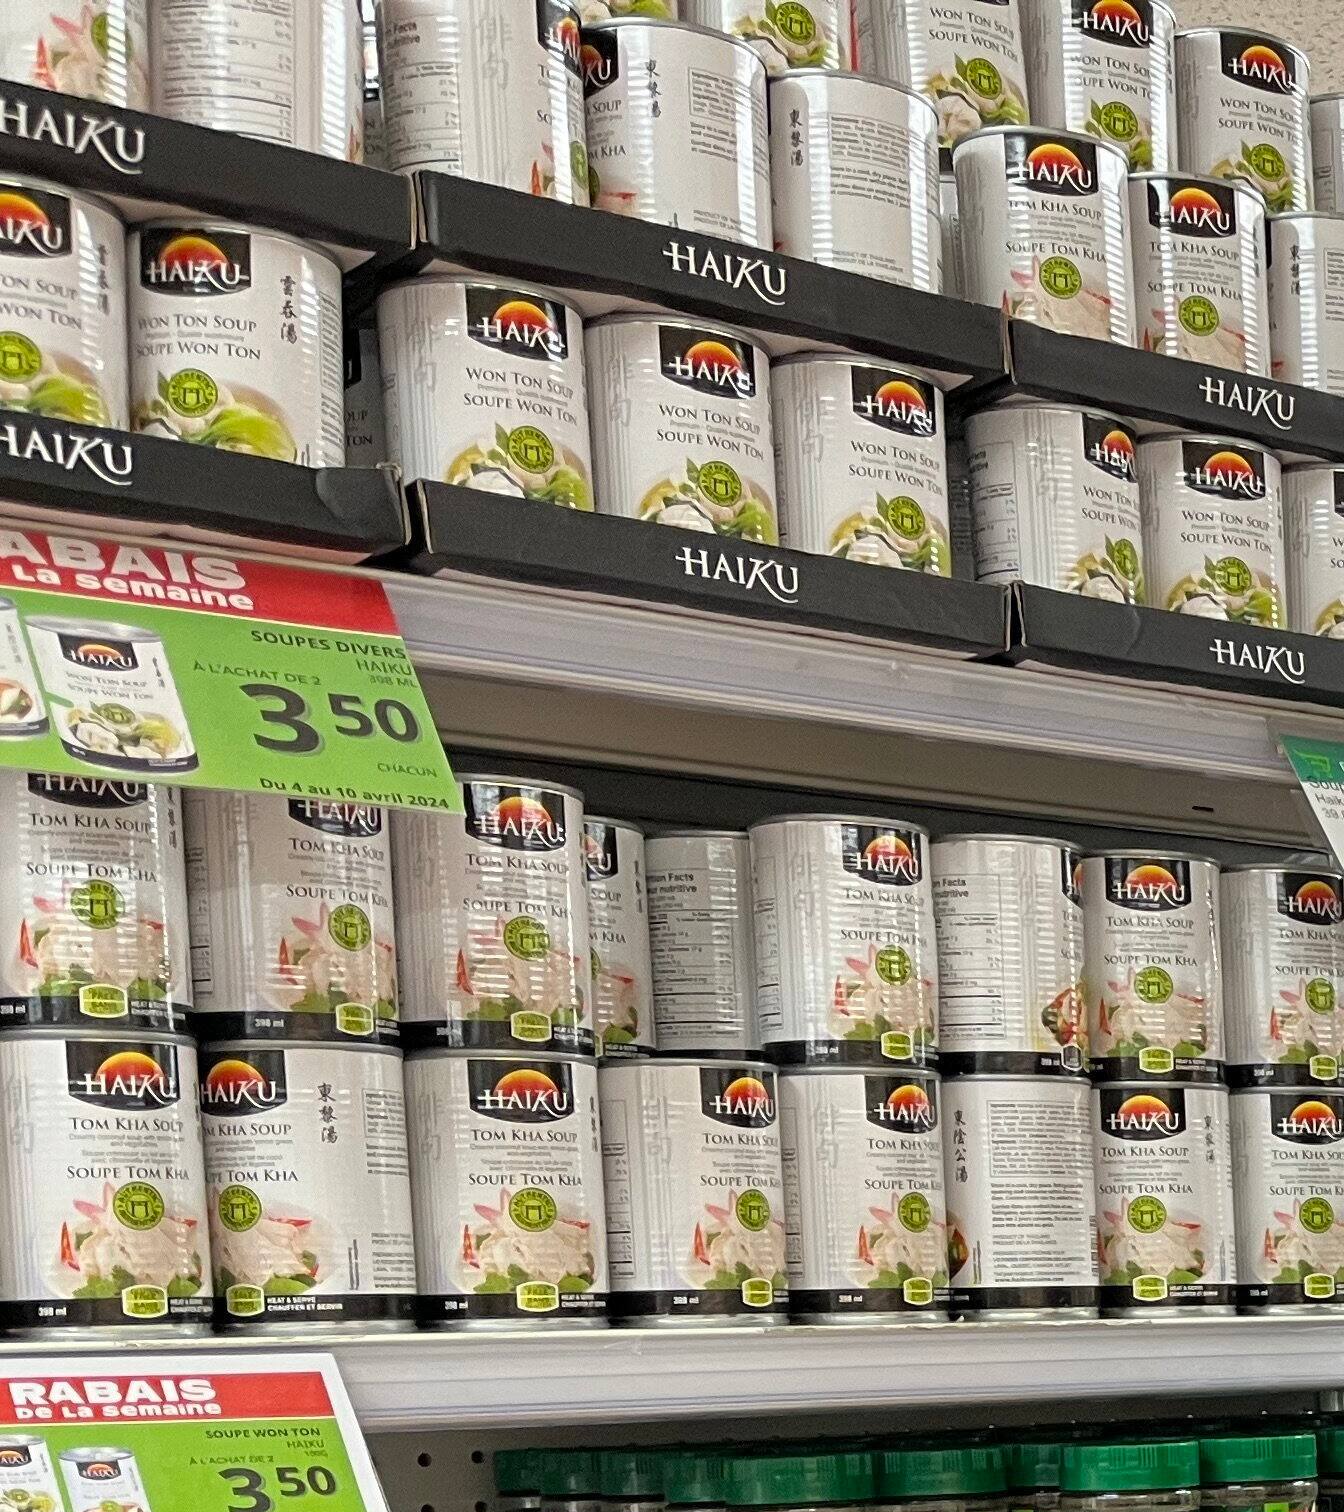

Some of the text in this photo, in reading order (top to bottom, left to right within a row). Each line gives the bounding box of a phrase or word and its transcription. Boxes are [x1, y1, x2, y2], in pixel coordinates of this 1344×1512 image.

[1081, 8, 1152, 46] HAIKU
[0, 100, 145, 175] HAIKU
[1016, 158, 1093, 198] HAIKU
[146, 258, 250, 287] HAIKU
[662, 241, 787, 306] HAIKU
[465, 365, 508, 384] WON
[512, 372, 545, 390] TON
[463, 391, 513, 411] SOUPE
[516, 398, 553, 417] WON
[1199, 376, 1296, 431] HAIKU
[12, 563, 254, 611] La semaine
[675, 547, 799, 604] HAIKU
[250, 629, 407, 660] SOUPES DIVERS
[209, 663, 278, 681] L'ACHAT
[284, 673, 309, 684] DE
[311, 675, 322, 686] 2
[356, 659, 413, 676] HAIKU
[1210, 638, 1306, 684] HAIKU
[239, 683, 420, 754] 3 50
[377, 762, 438, 778] CHACUN
[260, 777, 450, 809] Du 4 au 10 avril 2024
[1112, 881, 1186, 902] HAIKU
[77, 1072, 178, 1100] HAIKU
[483, 1086, 568, 1112] HAIKU
[69, 1116, 183, 1134] TOM KHA SOUP
[66, 1165, 190, 1182] SOUPE TOM KHA
[8, 1378, 217, 1406] RABAIS
[102, 1402, 222, 1418] semaine
[206, 1427, 321, 1440] SOUPE WON TON
[287, 1439, 325, 1449] HAIKU
[275, 1465, 336, 1496] 50
